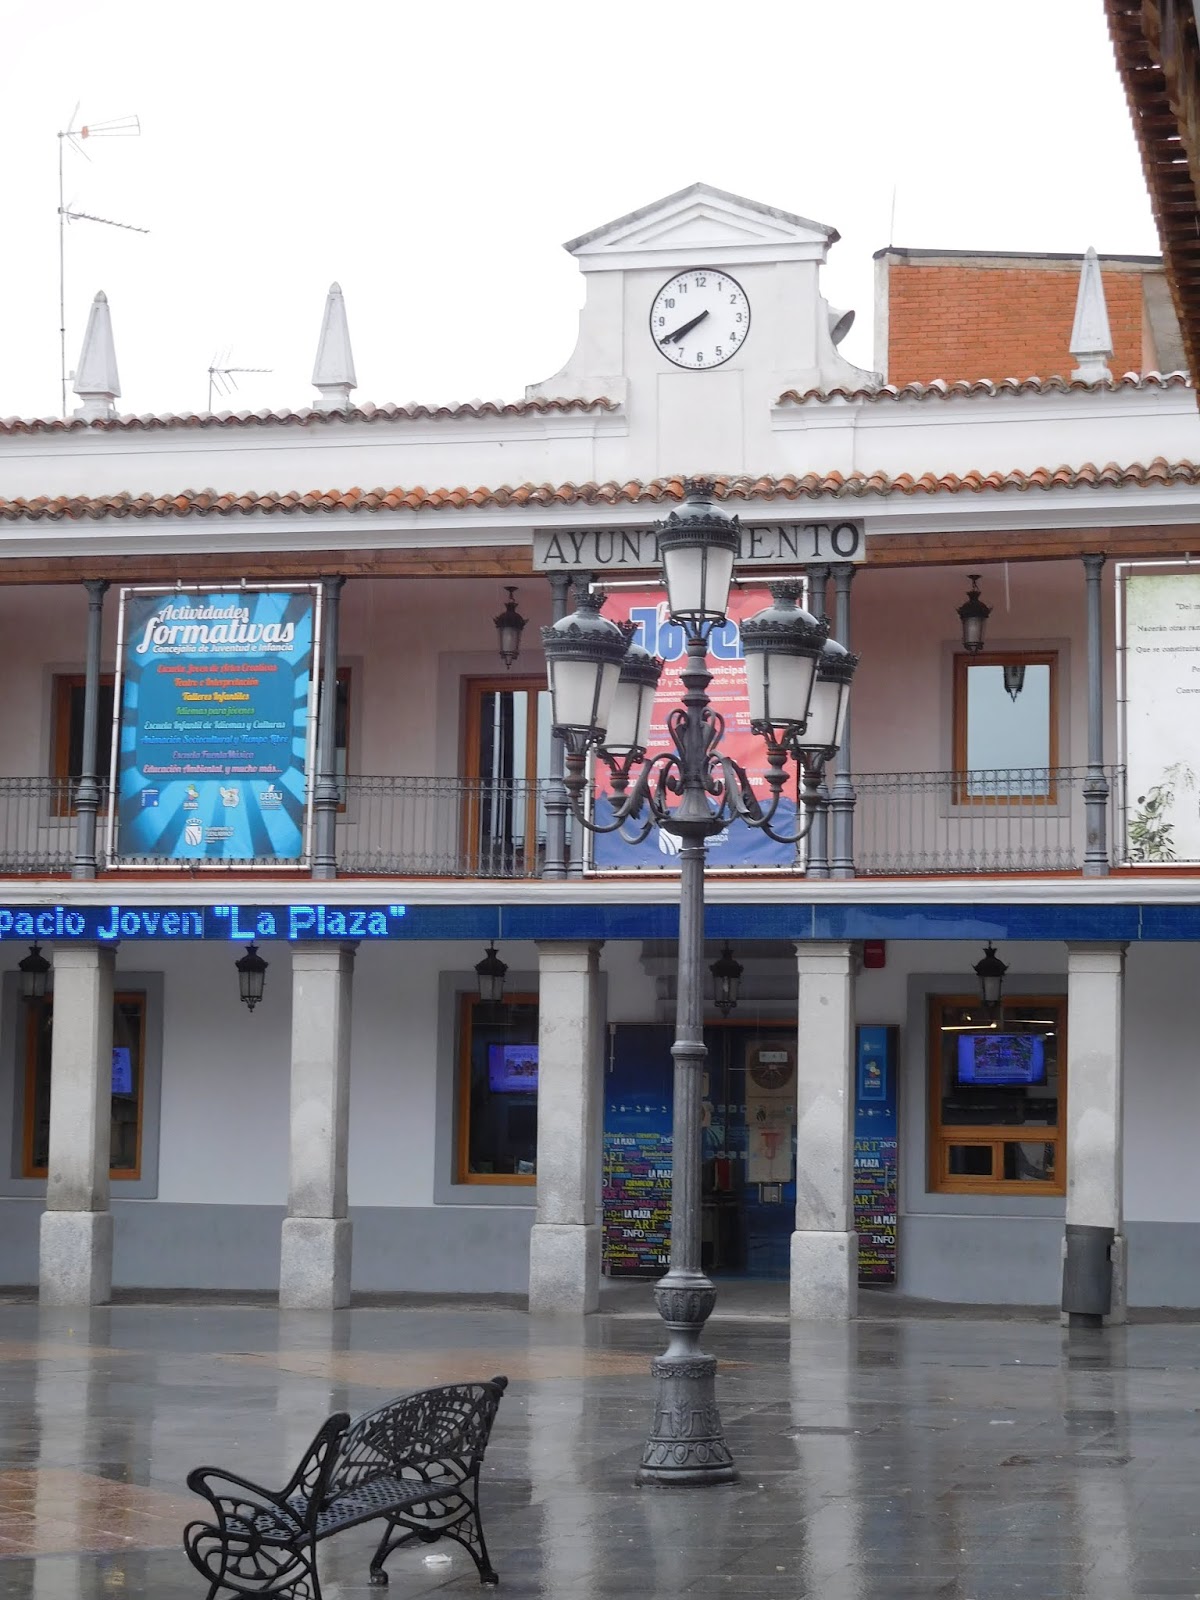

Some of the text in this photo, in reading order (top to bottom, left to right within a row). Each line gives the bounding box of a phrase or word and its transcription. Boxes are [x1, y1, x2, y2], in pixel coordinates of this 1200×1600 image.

[695, 277, 706, 287] 12
[718, 282, 722, 291] 1
[679, 284, 687, 293] 11
[664, 298, 675, 308] 10
[730, 294, 737, 304] 2
[659, 316, 665, 326] 9
[736, 313, 742, 322] 3
[729, 332, 736, 342] 4
[678, 347, 684, 357] 7
[716, 346, 722, 356] 5
[697, 352, 703, 362] 6
[543, 521, 859, 564] AYUNTIENTO
[159, 605, 249, 623] Actividades
[136, 617, 295, 654] formativas
[153, 645, 197, 655] Concejalía
[198, 644, 209, 653] de
[210, 644, 250, 653] Juventud
[258, 643, 294, 652] Infancia
[706, 664, 746, 676] unicipal
[144, 720, 286, 731] Escuela Infantil de Idiomas y Culturas
[143, 764, 182, 773] Educación
[97, 906, 203, 939] Joven
[214, 906, 277, 939] "La
[289, 906, 406, 939] Plaza"
[621, 1138, 635, 1146] PLAZA
[853, 1141, 878, 1151] ART
[879, 1141, 898, 1149] INFO
[602, 1151, 625, 1162] ART
[861, 1159, 880, 1168] PLAZA
[647, 1169, 656, 1178] LA
[655, 1179, 673, 1188] AR
[853, 1194, 877, 1205] ART
[624, 1209, 632, 1218] LA
[632, 1209, 651, 1219] PLAZA
[634, 1219, 658, 1229] ART
[873, 1215, 882, 1224] LA
[622, 1228, 643, 1238] INFO
[872, 1235, 895, 1244] INFO
[658, 1254, 666, 1263] LA
